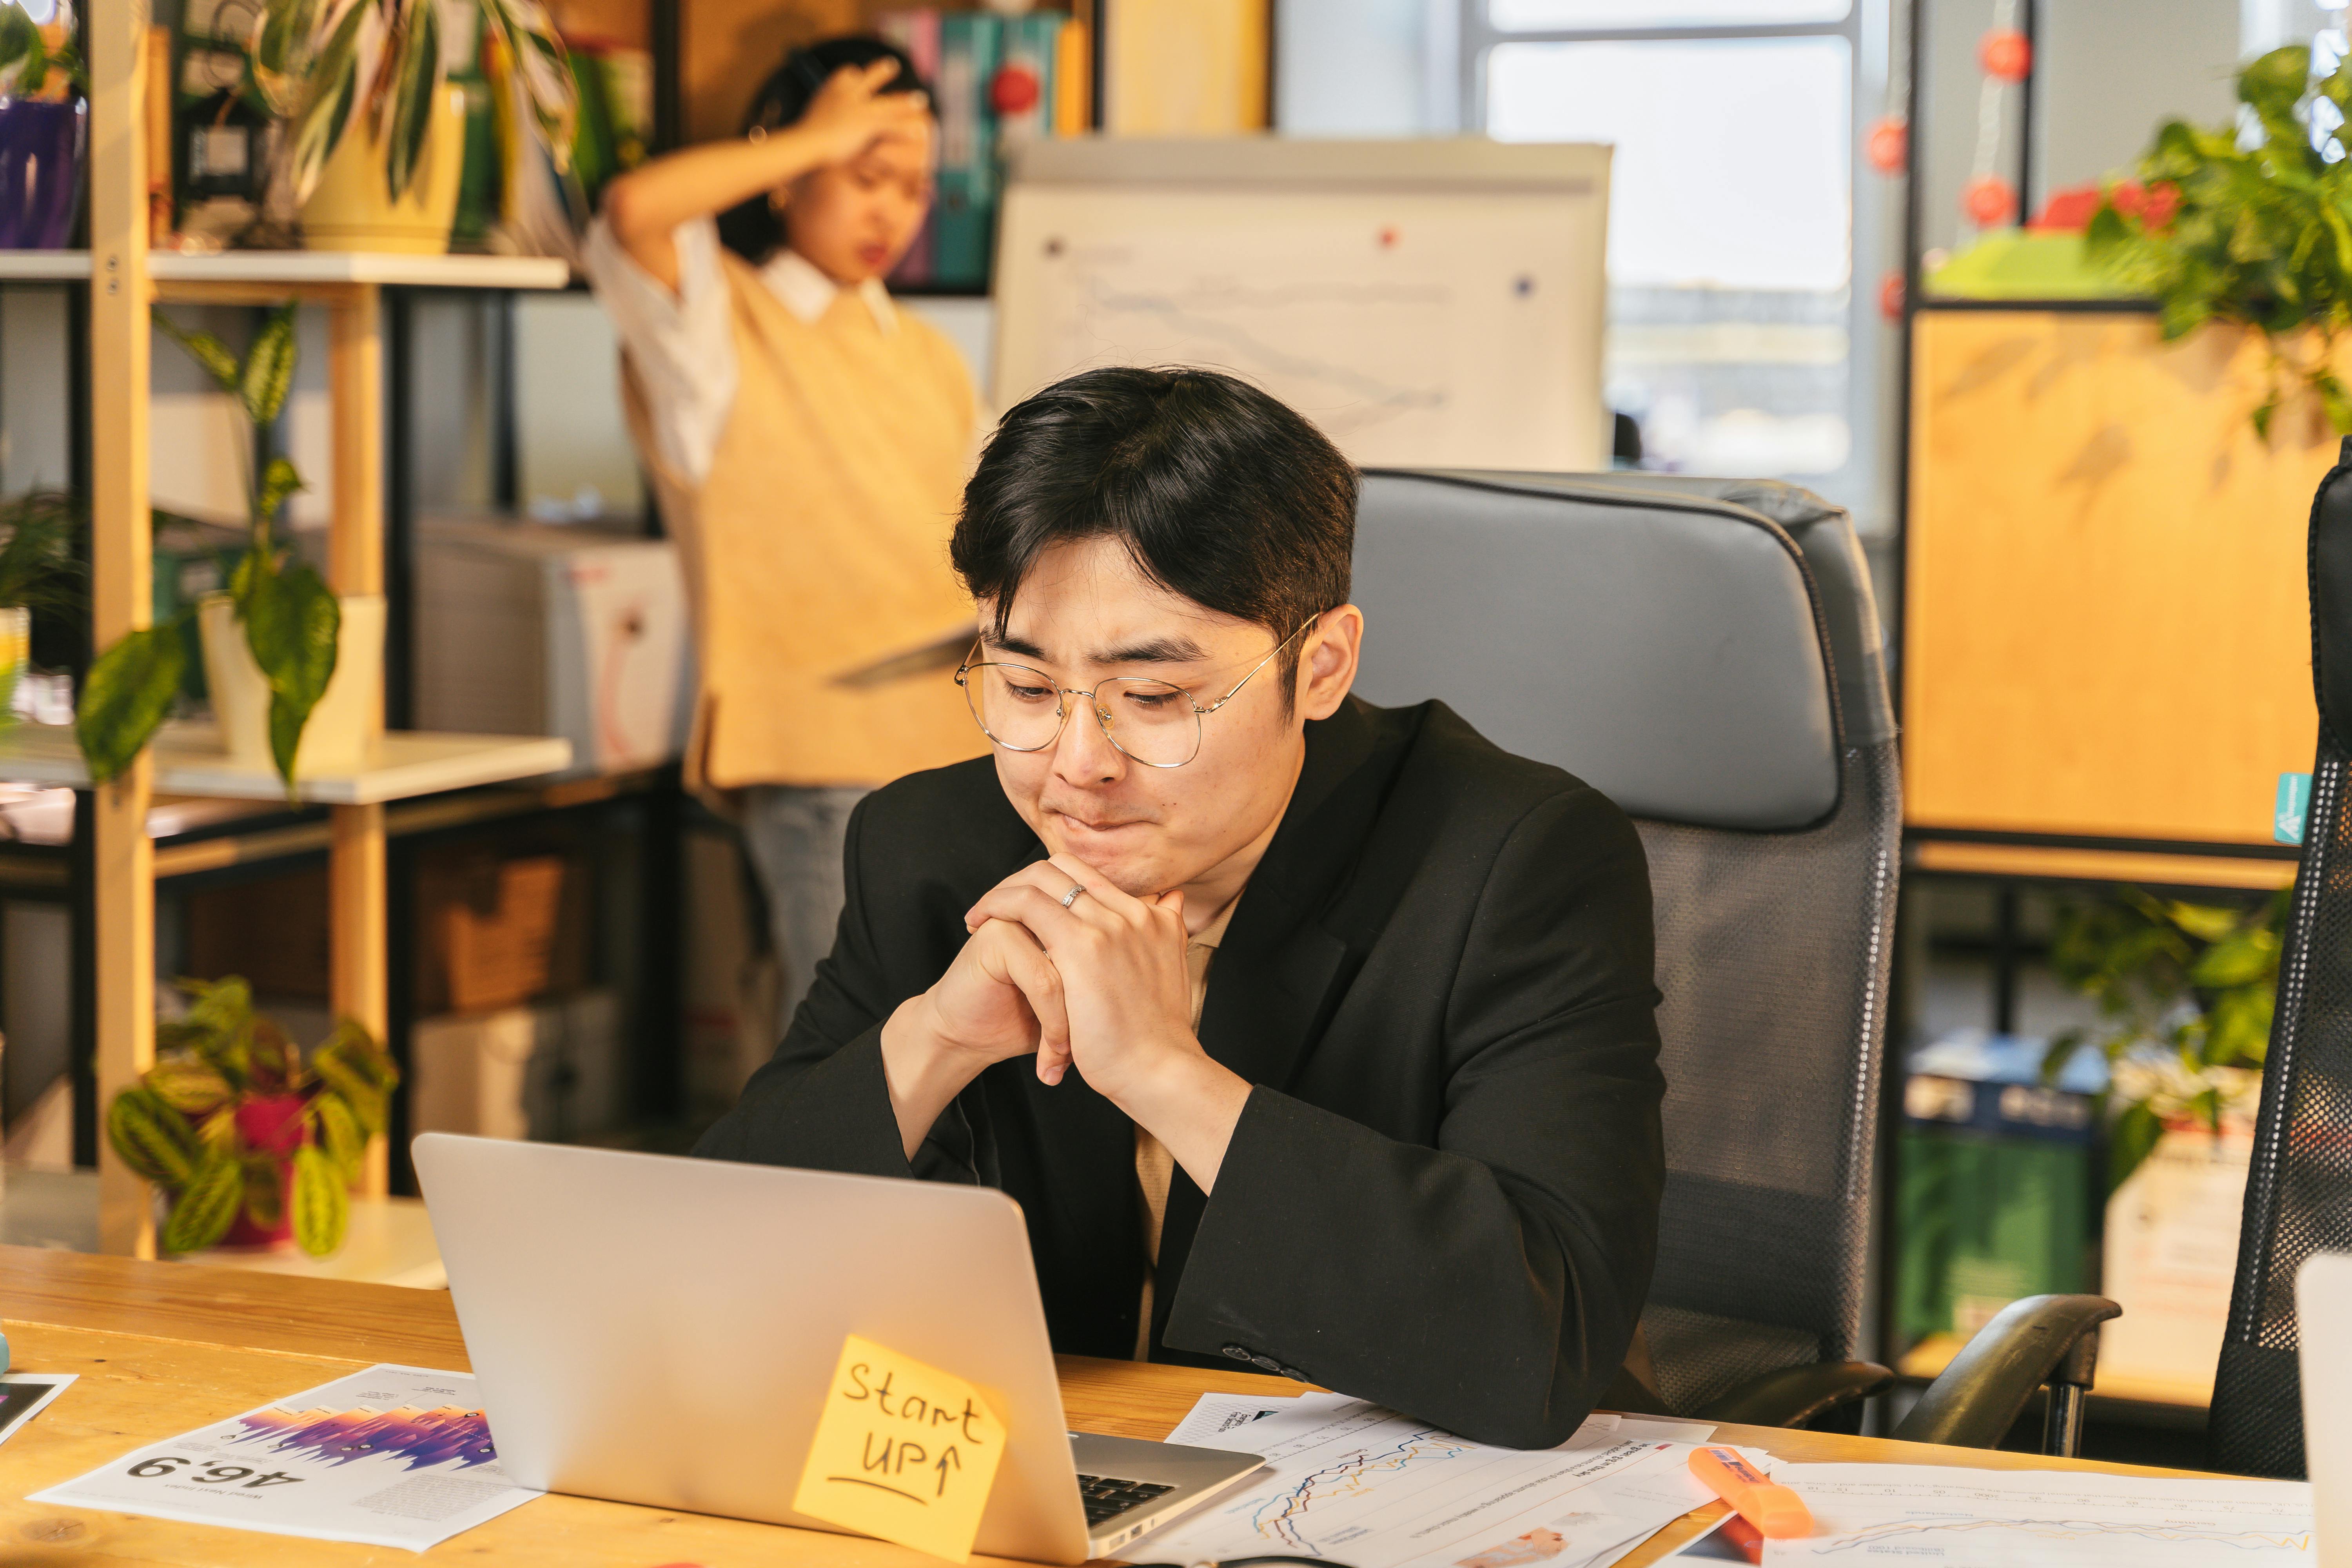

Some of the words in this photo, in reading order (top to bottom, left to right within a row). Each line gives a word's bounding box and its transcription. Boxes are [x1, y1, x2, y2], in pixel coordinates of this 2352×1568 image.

[843, 1363, 982, 1445] Start
[863, 1432, 927, 1474] UP
[1336, 1449, 1368, 1459] Germany
[1619, 1447, 1642, 1457] great
[1581, 1455, 1604, 1465] albums
[1605, 1456, 1623, 1465] gig
[126, 1457, 307, 1489] 46,9
[1513, 1483, 1537, 1493] albums
[226, 1492, 263, 1500] Wired
[1480, 1492, 1516, 1506] appearing
